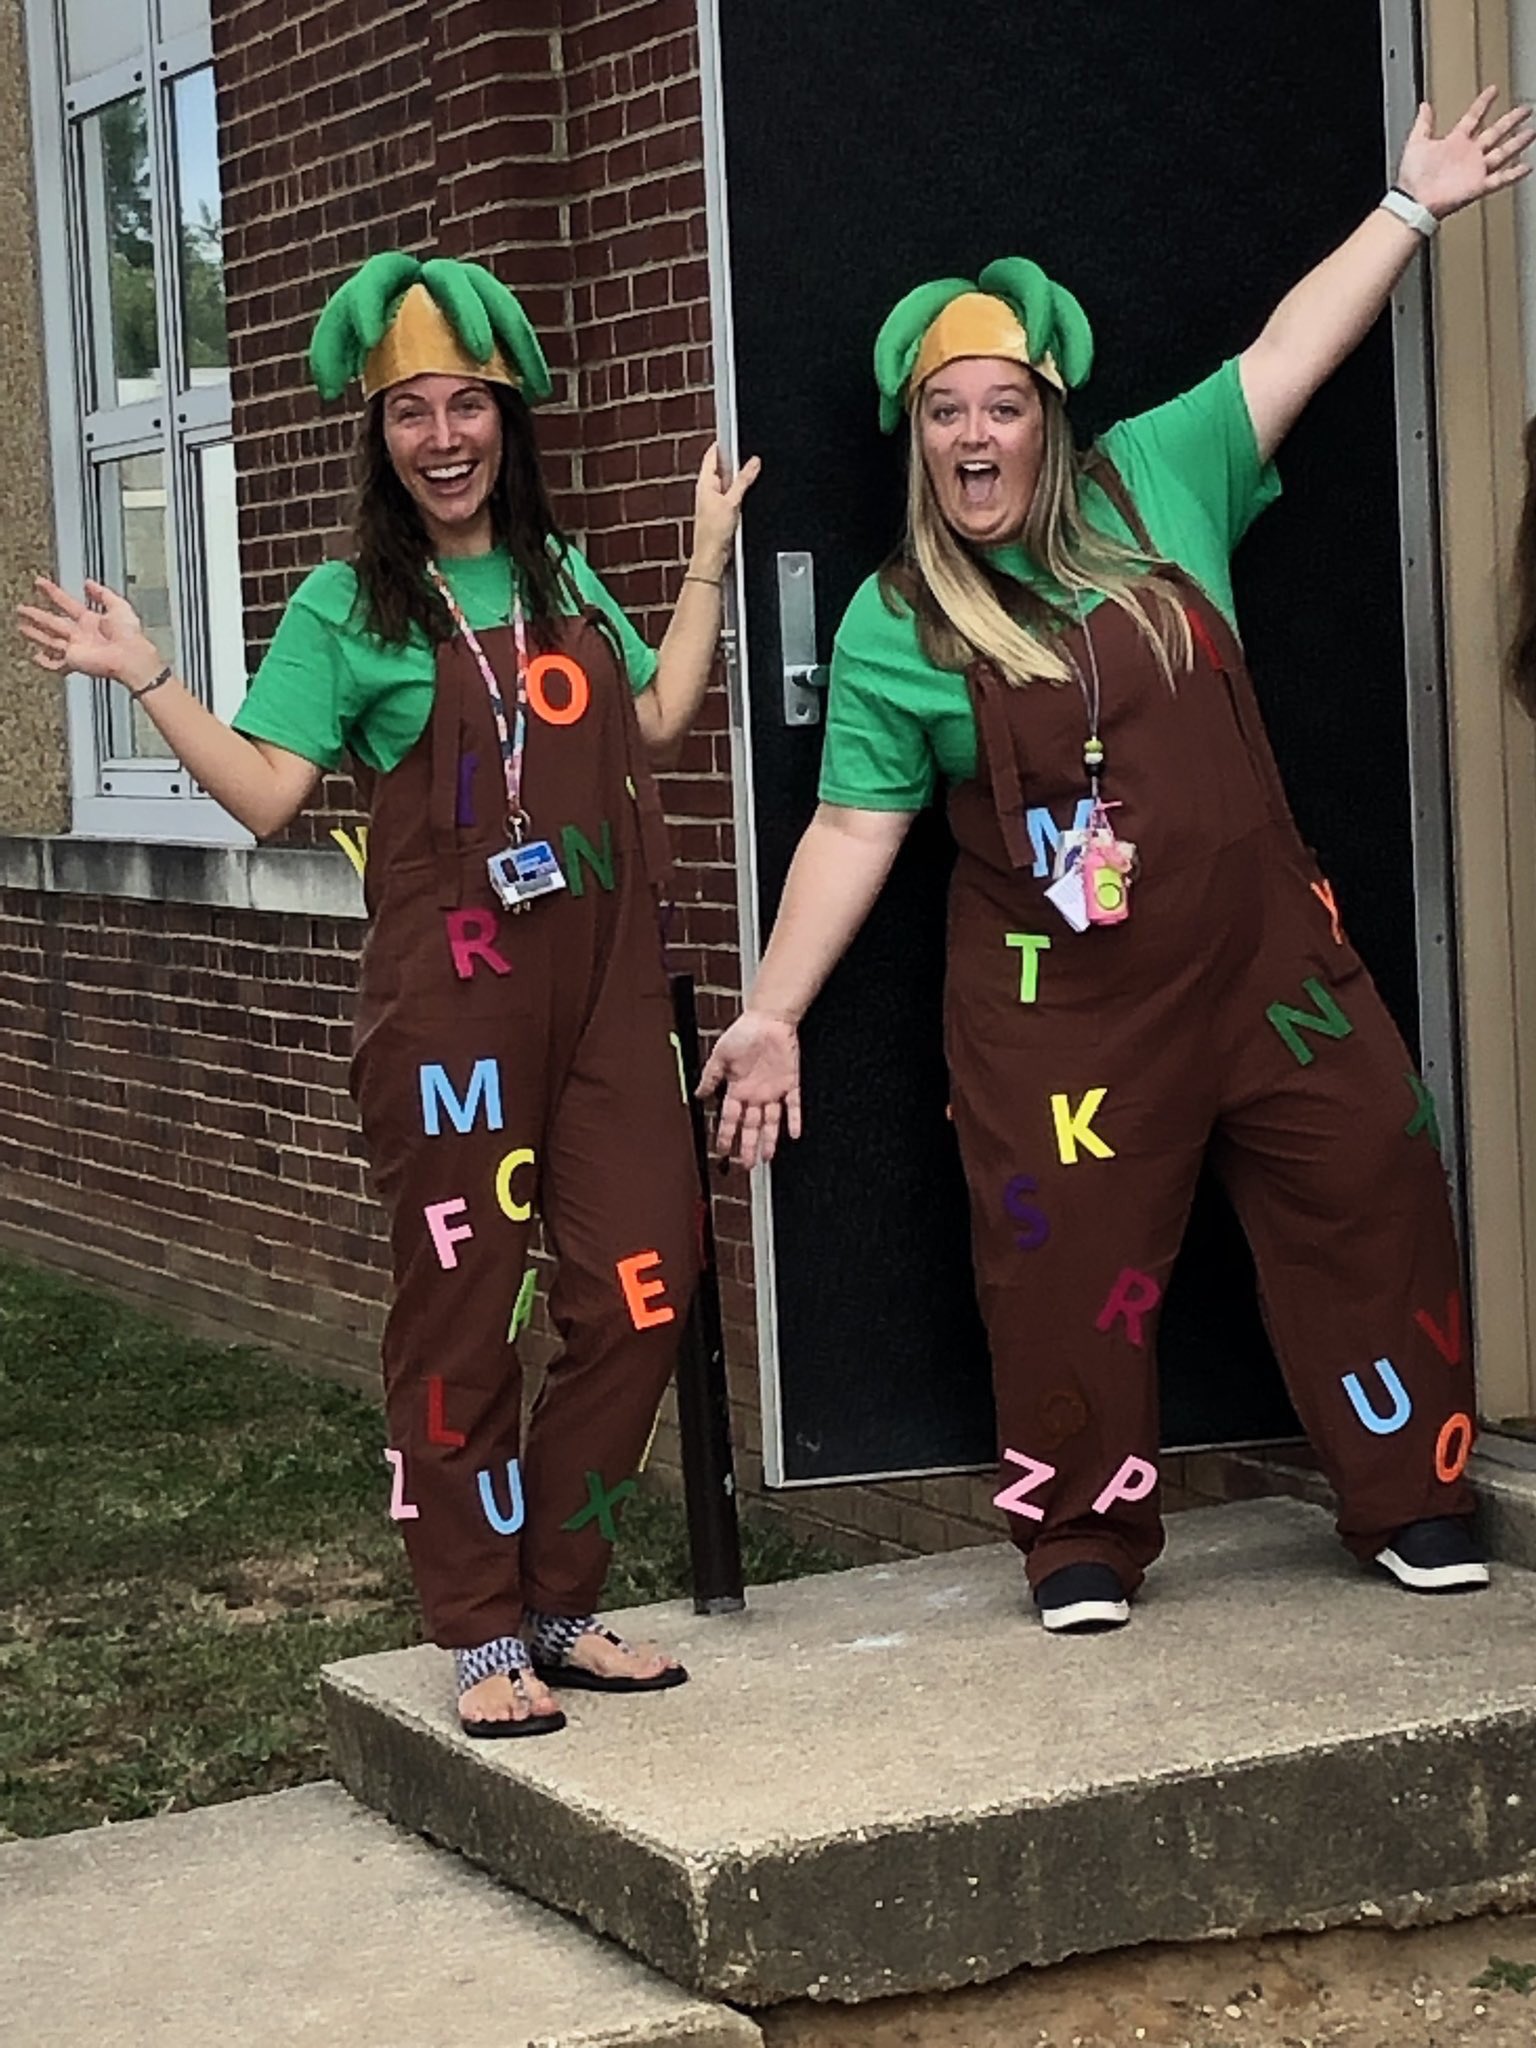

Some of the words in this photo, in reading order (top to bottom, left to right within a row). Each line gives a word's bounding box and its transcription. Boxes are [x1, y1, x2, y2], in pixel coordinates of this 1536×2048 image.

[526, 654, 588, 725] O
[561, 821, 614, 896] N
[446, 907, 512, 980] R
[1005, 933, 1050, 1003] T
[420, 1058, 503, 1135] M
[1050, 1087, 1116, 1164] K
[496, 1148, 534, 1221] C
[1004, 1173, 1048, 1249] S
[424, 1197, 474, 1269] F
[616, 1250, 675, 1330] E
[1096, 1267, 1161, 1348] R
[1414, 1289, 1461, 1364] V
[428, 1376, 465, 1446] L
[1341, 1357, 1412, 1435] U
[477, 1458, 524, 1535] U
[560, 1471, 637, 1540] X
[993, 1448, 1056, 1522] Z
[1091, 1454, 1158, 1514] P
